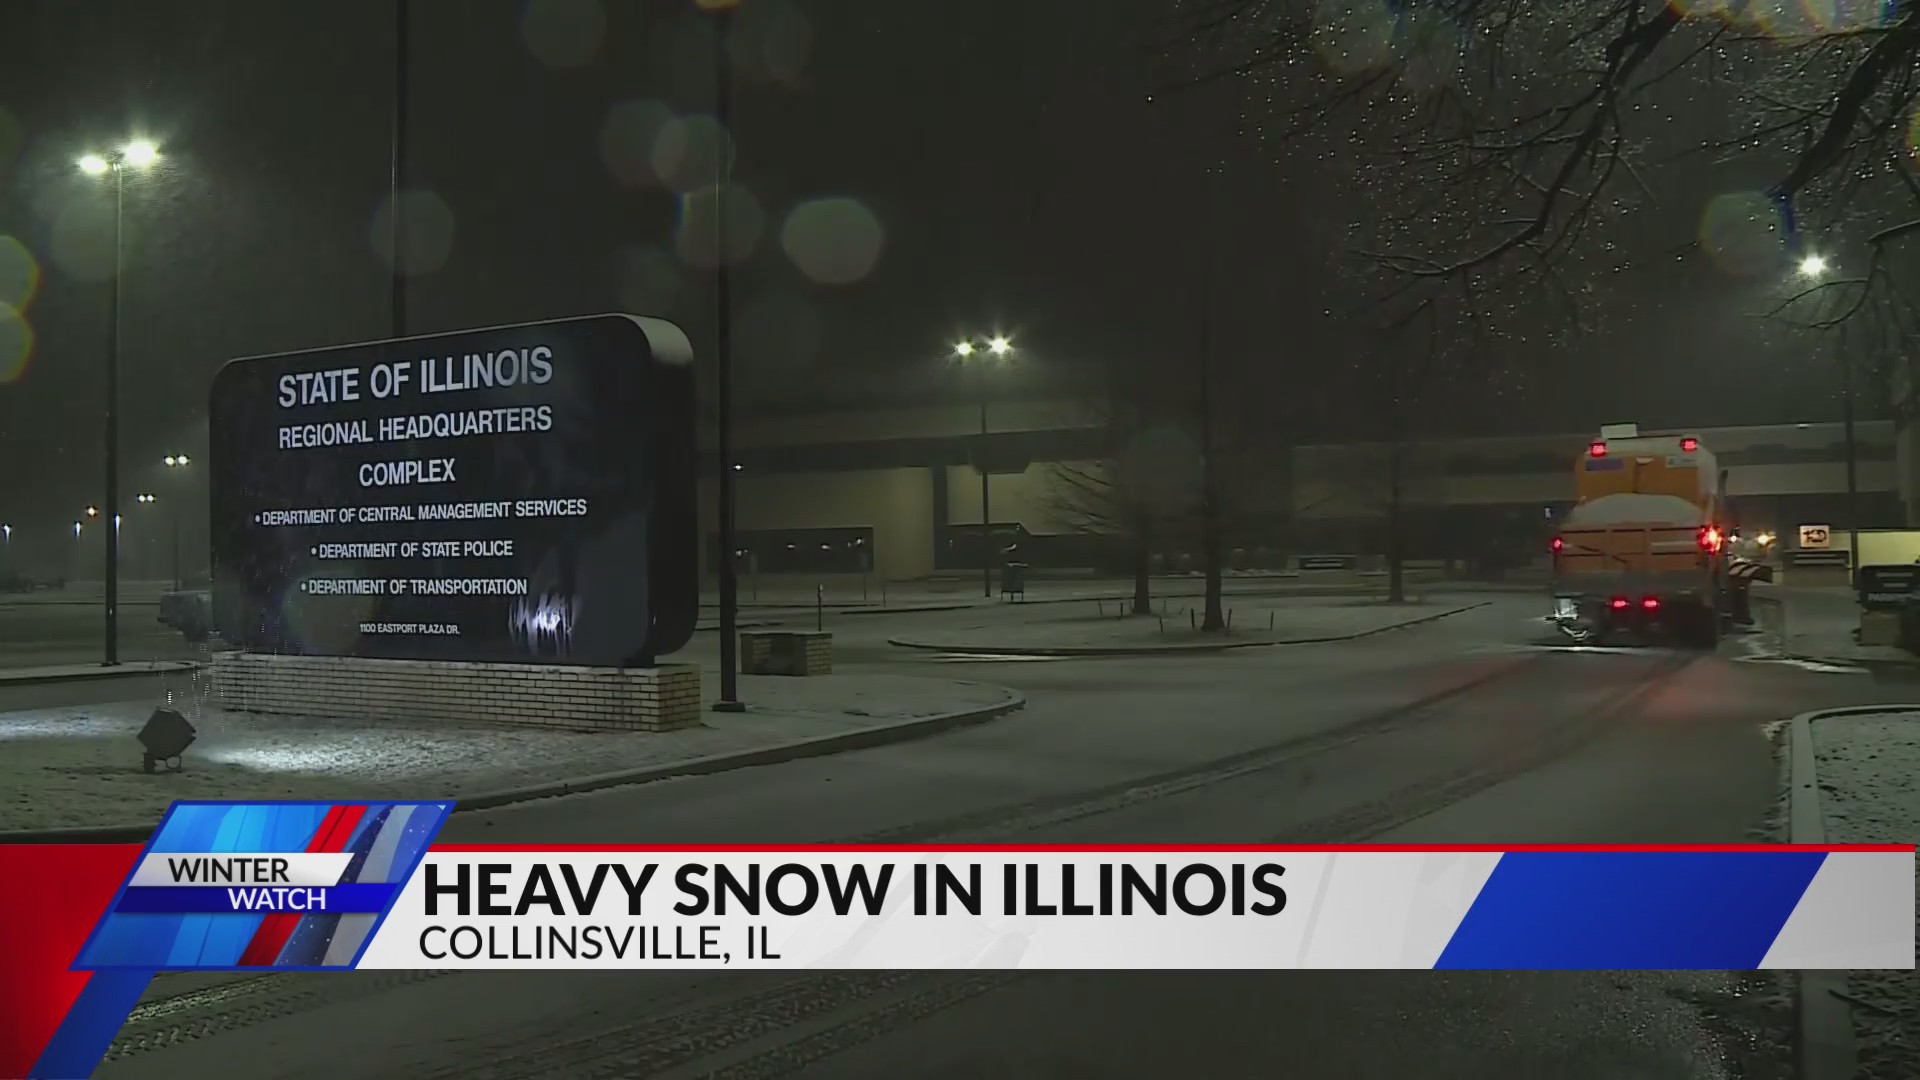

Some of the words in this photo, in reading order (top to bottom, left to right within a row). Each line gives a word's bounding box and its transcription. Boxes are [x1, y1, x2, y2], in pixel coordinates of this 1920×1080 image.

[279, 365, 360, 408] STATE
[370, 362, 411, 398] OF
[420, 346, 553, 393] ILLINOIS
[279, 420, 373, 449] REGIONAL
[379, 405, 553, 441] HEADQUARTERS
[359, 458, 456, 487] COMPLEX
[262, 508, 336, 526] DEPARTMENT
[339, 507, 356, 523] OF
[358, 504, 415, 522] CENTRAL
[418, 502, 512, 520] MANAGEMENT
[515, 499, 587, 517] SERVICES
[319, 543, 397, 559] DEPARTMENT
[400, 543, 418, 557] OF
[422, 541, 460, 557] STATE
[464, 540, 513, 556] POLICE
[308, 580, 386, 595] DEPARTMENT
[389, 580, 407, 595] OF
[410, 579, 527, 595] TRANSPORTATION
[359, 623, 376, 633] 1100
[377, 623, 418, 634] EASTPORT
[418, 624, 445, 634] PLAZA
[446, 625, 460, 635] DR.
